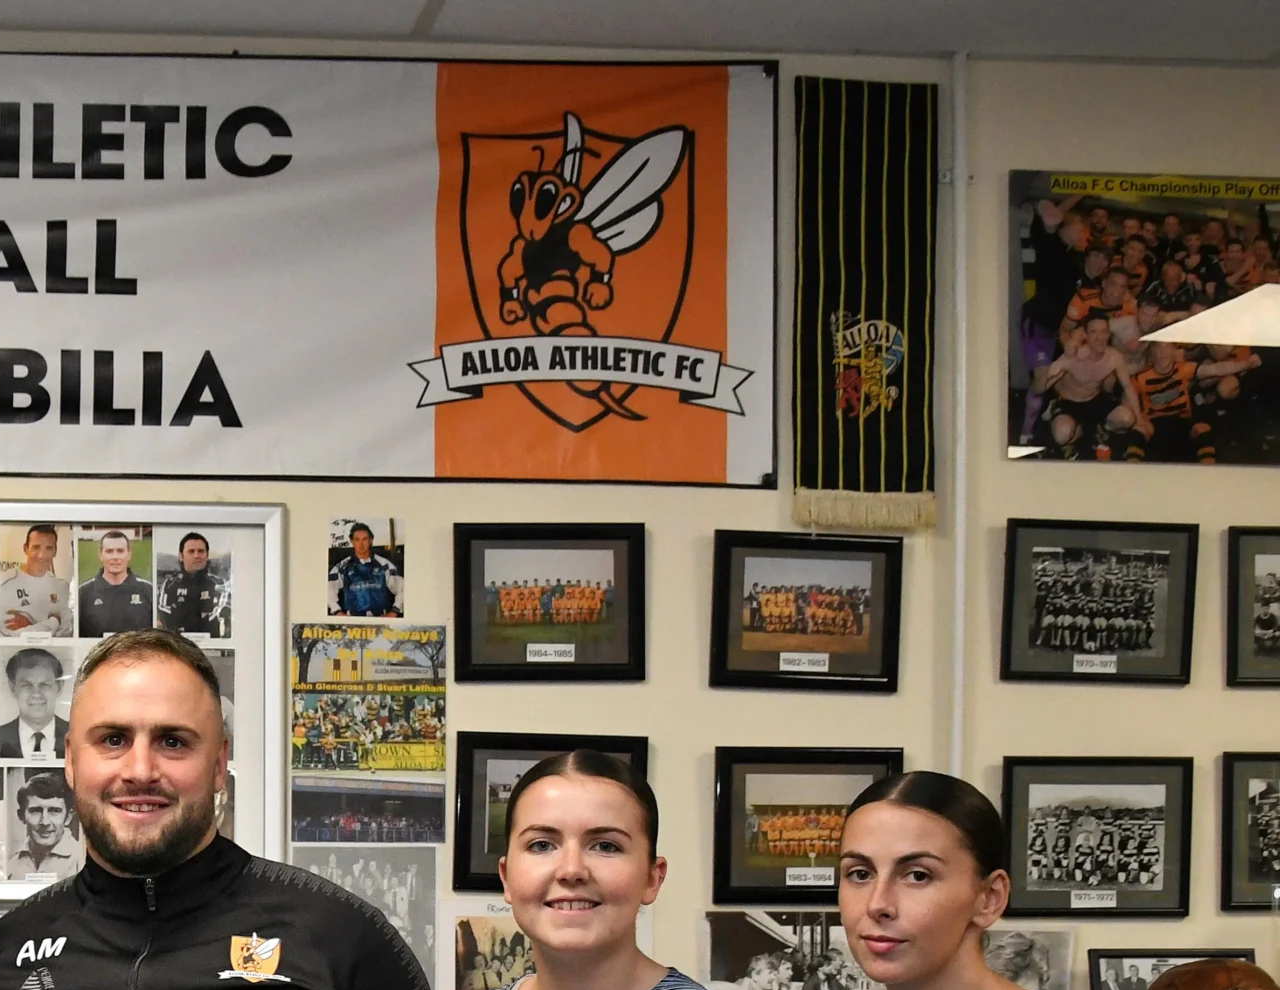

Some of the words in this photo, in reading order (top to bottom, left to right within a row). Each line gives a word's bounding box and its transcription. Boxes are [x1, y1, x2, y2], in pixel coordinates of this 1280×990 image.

[1052, 177, 1087, 191] Alloa
[1120, 180, 1220, 197] Championship
[1225, 182, 1254, 199] Play
[460, 345, 539, 377] ALLOA
[549, 346, 665, 377] ATHLETIC
[675, 355, 705, 383] FC
[17, 588, 29, 600] DL
[302, 627, 343, 640] Alloa
[347, 627, 377, 640] Will
[528, 649, 573, 658] 1984-1985
[315, 683, 363, 692] Glencross
[377, 684, 406, 692] Stuart
[16, 936, 67, 967] AM
